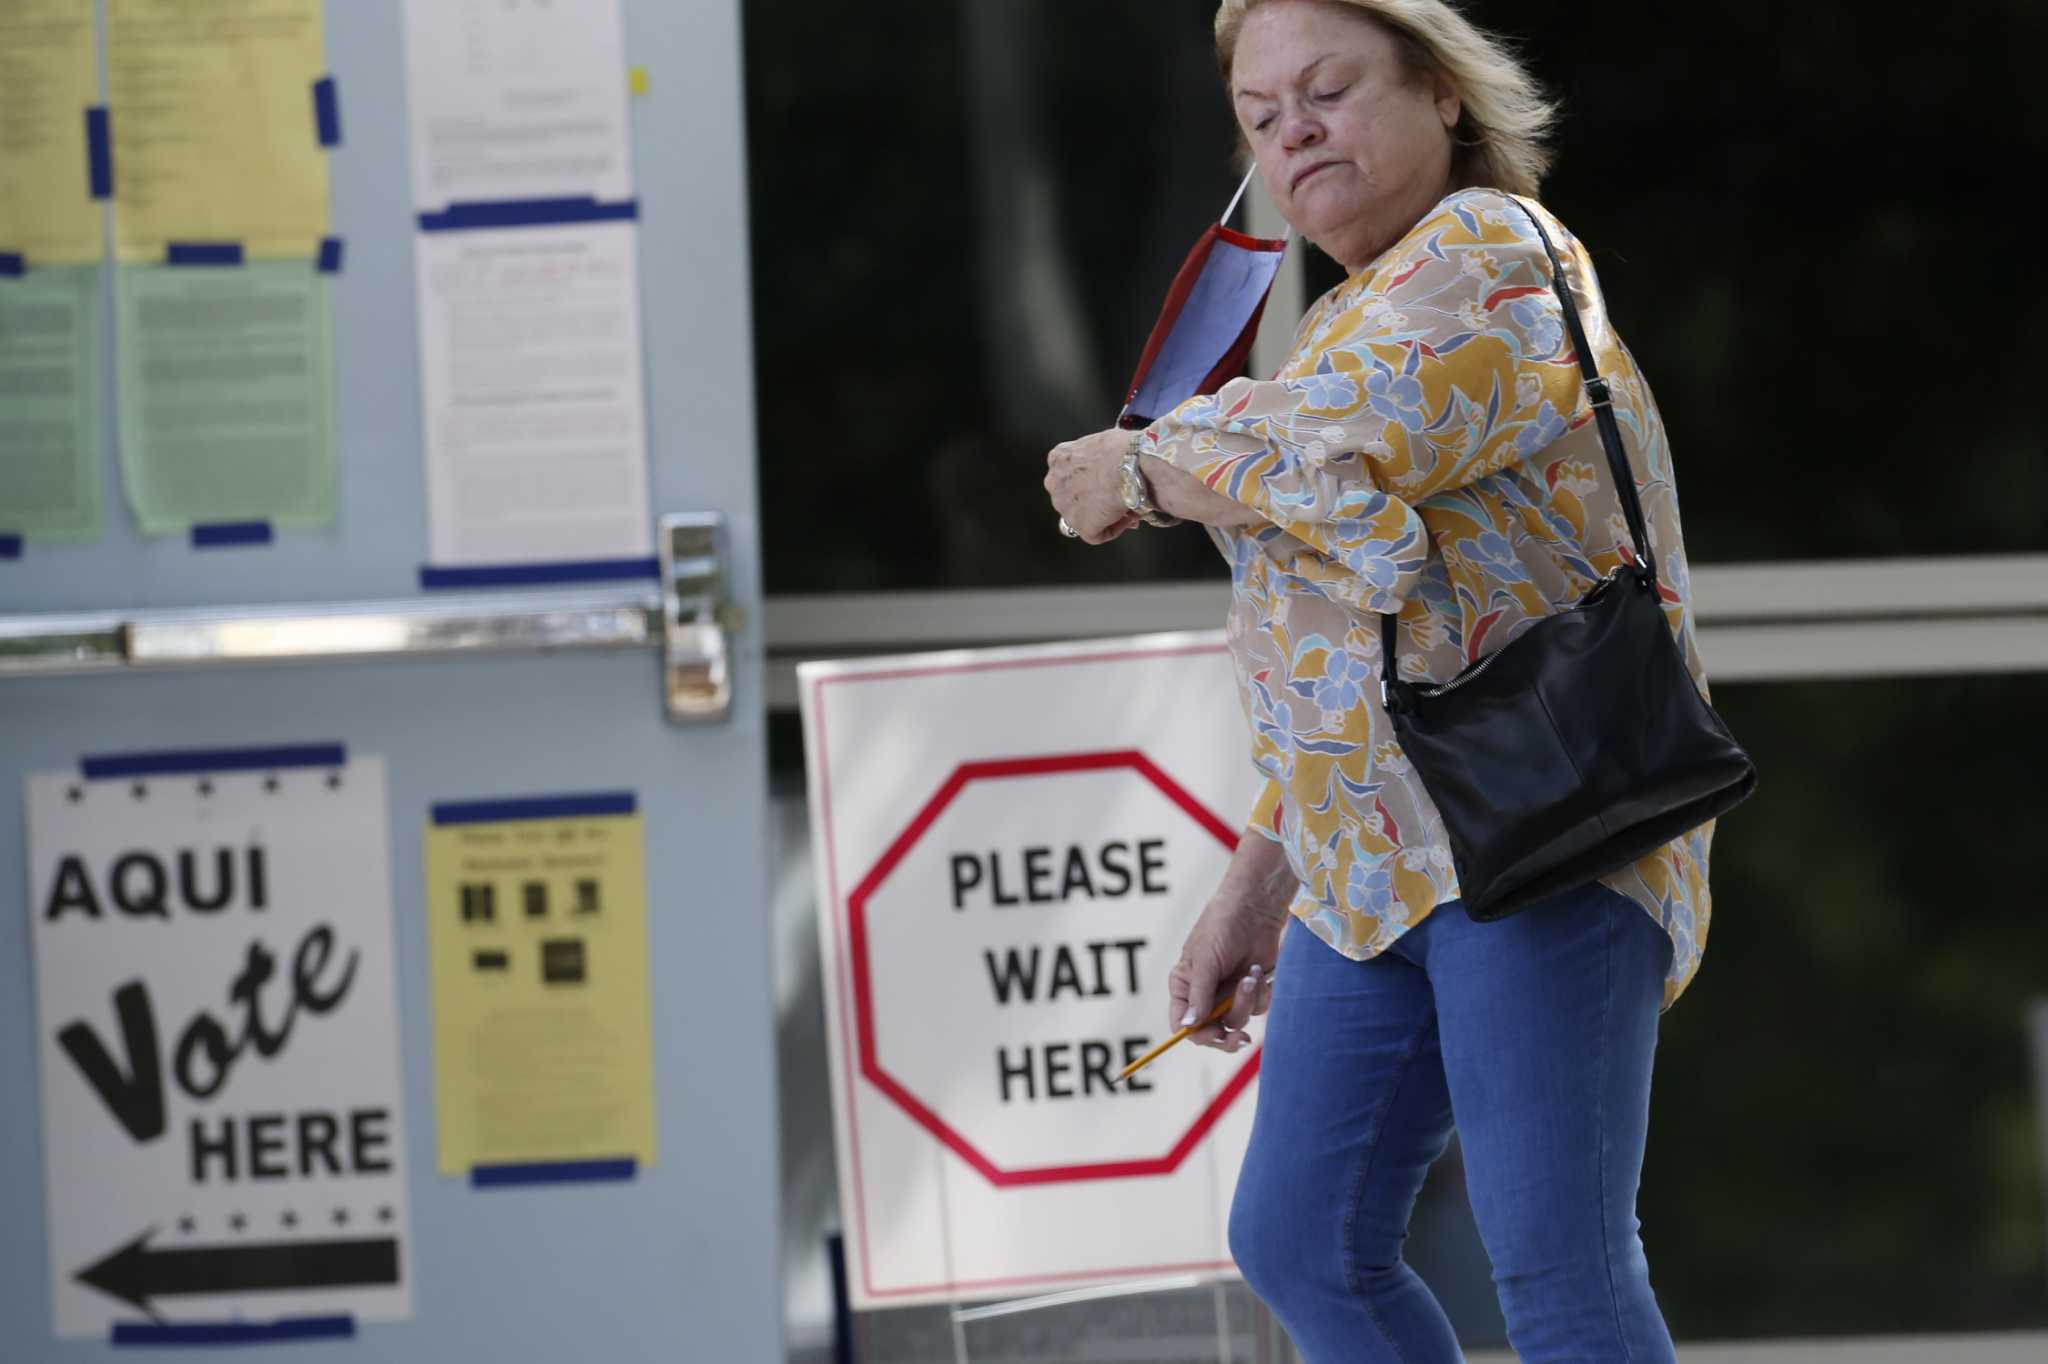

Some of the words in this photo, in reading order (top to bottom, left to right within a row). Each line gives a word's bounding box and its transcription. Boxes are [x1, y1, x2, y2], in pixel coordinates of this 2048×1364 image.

[951, 839, 1167, 909] PLEASE
[984, 939, 1148, 1005] WAIT
[55, 922, 361, 1144] Vote
[997, 1036, 1155, 1101] HERE
[188, 1107, 393, 1185] HERE
